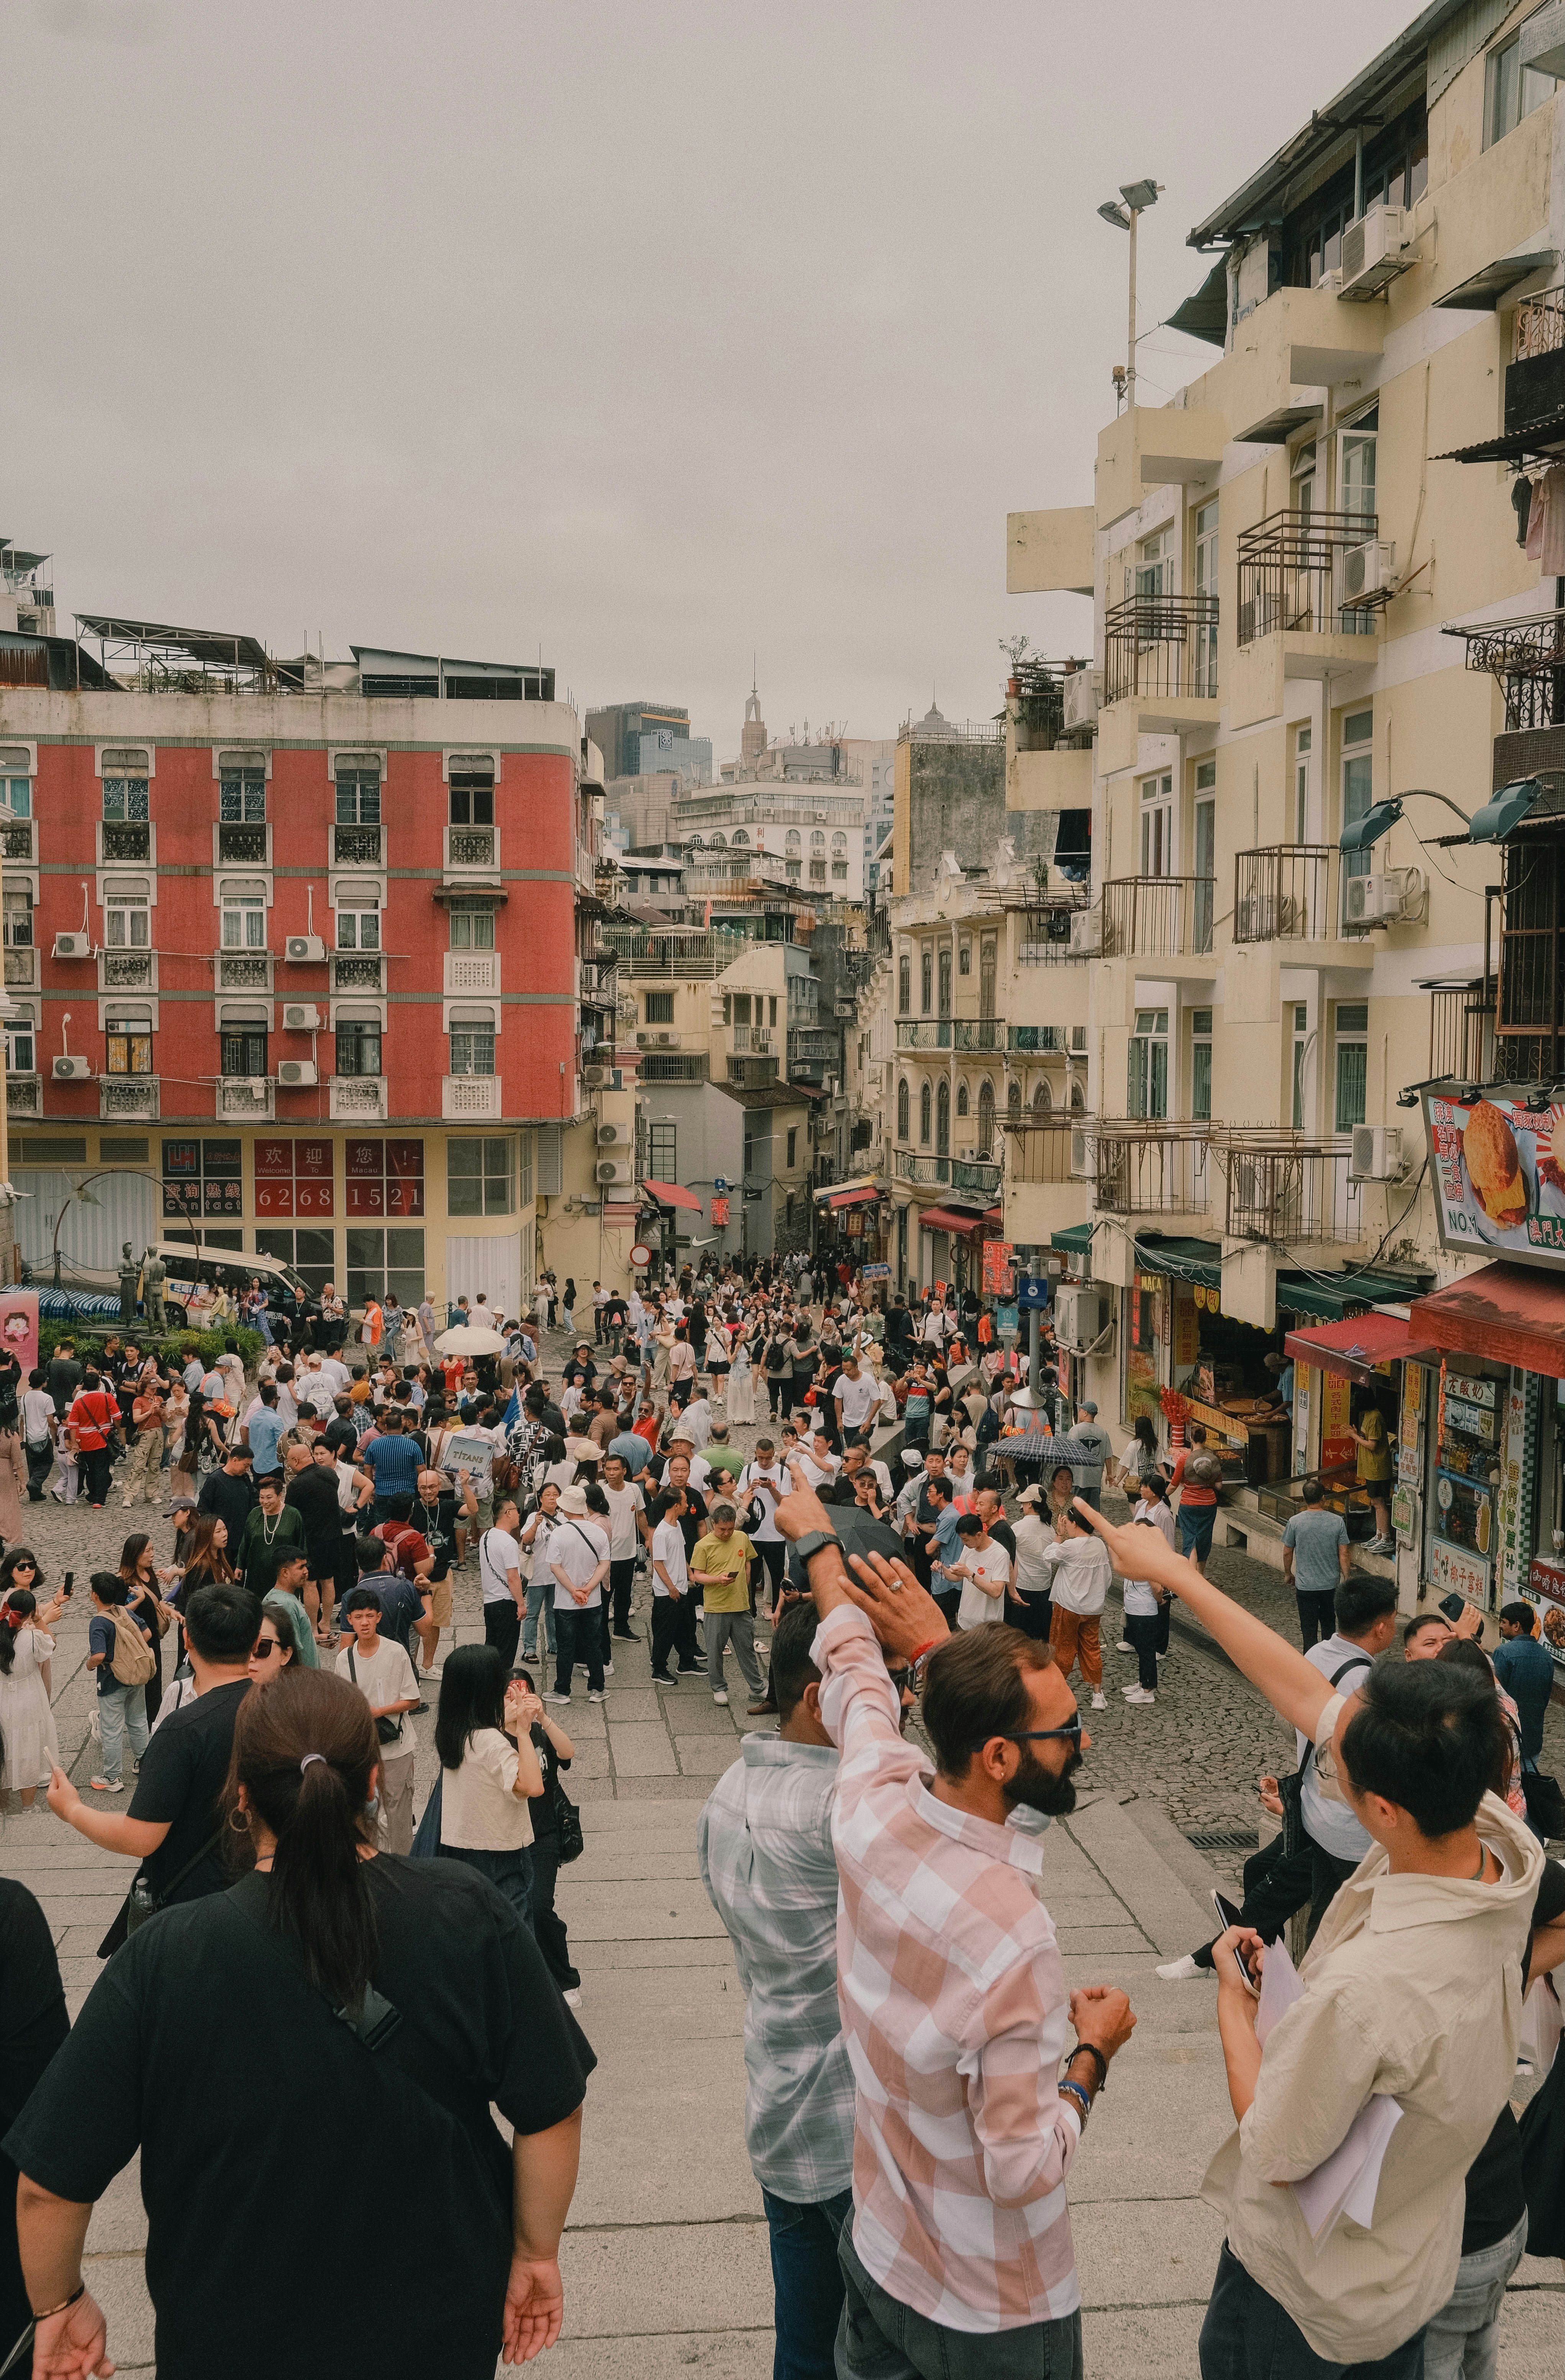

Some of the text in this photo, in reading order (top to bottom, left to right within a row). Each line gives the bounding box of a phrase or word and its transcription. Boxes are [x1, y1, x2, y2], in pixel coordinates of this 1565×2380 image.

[1512, 1109, 1554, 1131] 獨家秘制
[265, 1147, 323, 1164] 欢迎
[1434, 1103, 1456, 1201] 排名第一位
[1443, 1103, 1464, 1202] 澳門必食榜
[166, 1183, 241, 1198] 查询热线
[166, 1200, 241, 1210] Contact
[1447, 1209, 1479, 1235] NO.1
[1331, 1391, 1341, 1420] 各式肉干
[453, 1449, 484, 1463] TITANS
[1403, 1452, 1414, 1464] 共享
[1400, 1462, 1417, 1476] 充电宝
[1450, 1561, 1483, 1597] 椰子雪糕
